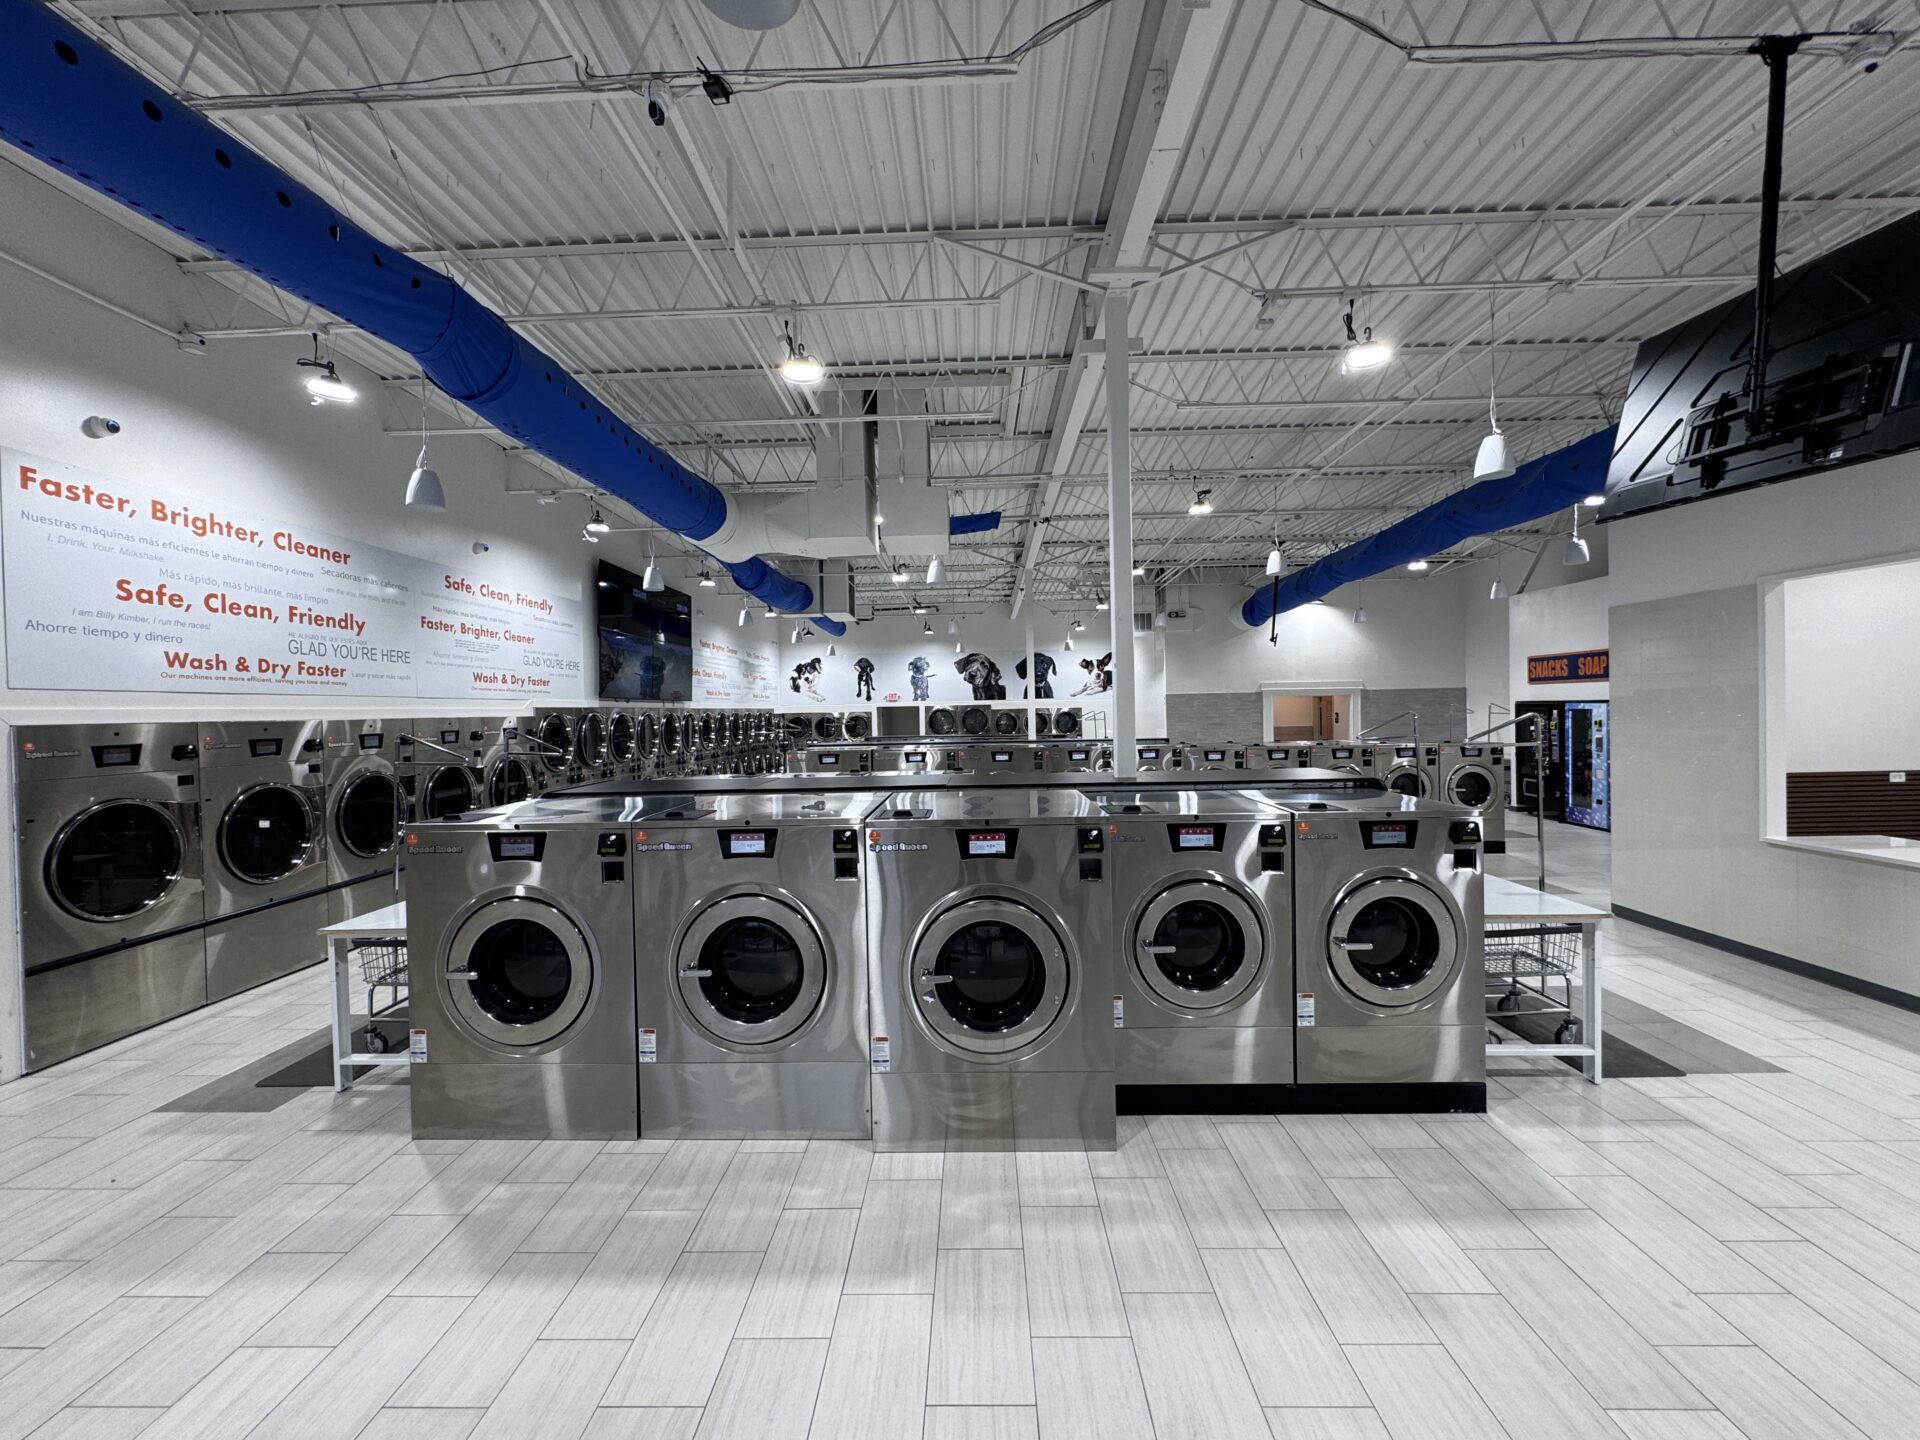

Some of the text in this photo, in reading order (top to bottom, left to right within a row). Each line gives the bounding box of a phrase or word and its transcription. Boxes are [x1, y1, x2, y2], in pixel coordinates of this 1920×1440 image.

[19, 465, 351, 565] Faster, Brighter, Cleaner
[21, 510, 77, 531] Nuestras
[81, 523, 135, 543] máquinas
[138, 534, 159, 547] más
[162, 541, 209, 558] eficientes
[211, 551, 220, 560] le
[222, 553, 255, 567] ahorran
[256, 560, 283, 573] tiempo
[291, 567, 314, 578] dinero
[57, 535, 88, 548] Drink.
[159, 568, 329, 605] Más rápido, más brillante, más limpio
[321, 566, 362, 583] Secadoras
[364, 577, 378, 586] más
[115, 579, 366, 636] Safe, Clean, Friendly
[444, 575, 475, 596] Safe,
[480, 584, 513, 605] Clean,
[516, 592, 553, 615] Friendly
[24, 619, 183, 644] Ahorre tiempo y dinero
[96, 610, 115, 621] Billy
[117, 613, 151, 624] Kimber,
[173, 620, 186, 628] the
[421, 616, 535, 644] Faster, Brighter, Cleaner
[288, 639, 411, 664] GLAD YOU'RE HERE
[523, 656, 540, 667] GLAD
[565, 660, 580, 671] HERE
[164, 650, 347, 679] Wash & Dry Faster
[178, 673, 212, 681] machines
[1530, 656, 1608, 679] SNACKS SOAP
[472, 672, 498, 683] Wash
[501, 674, 508, 684] &
[511, 675, 525, 688] Dry
[528, 676, 550, 686] Faster
[869, 843, 898, 852] Speed
